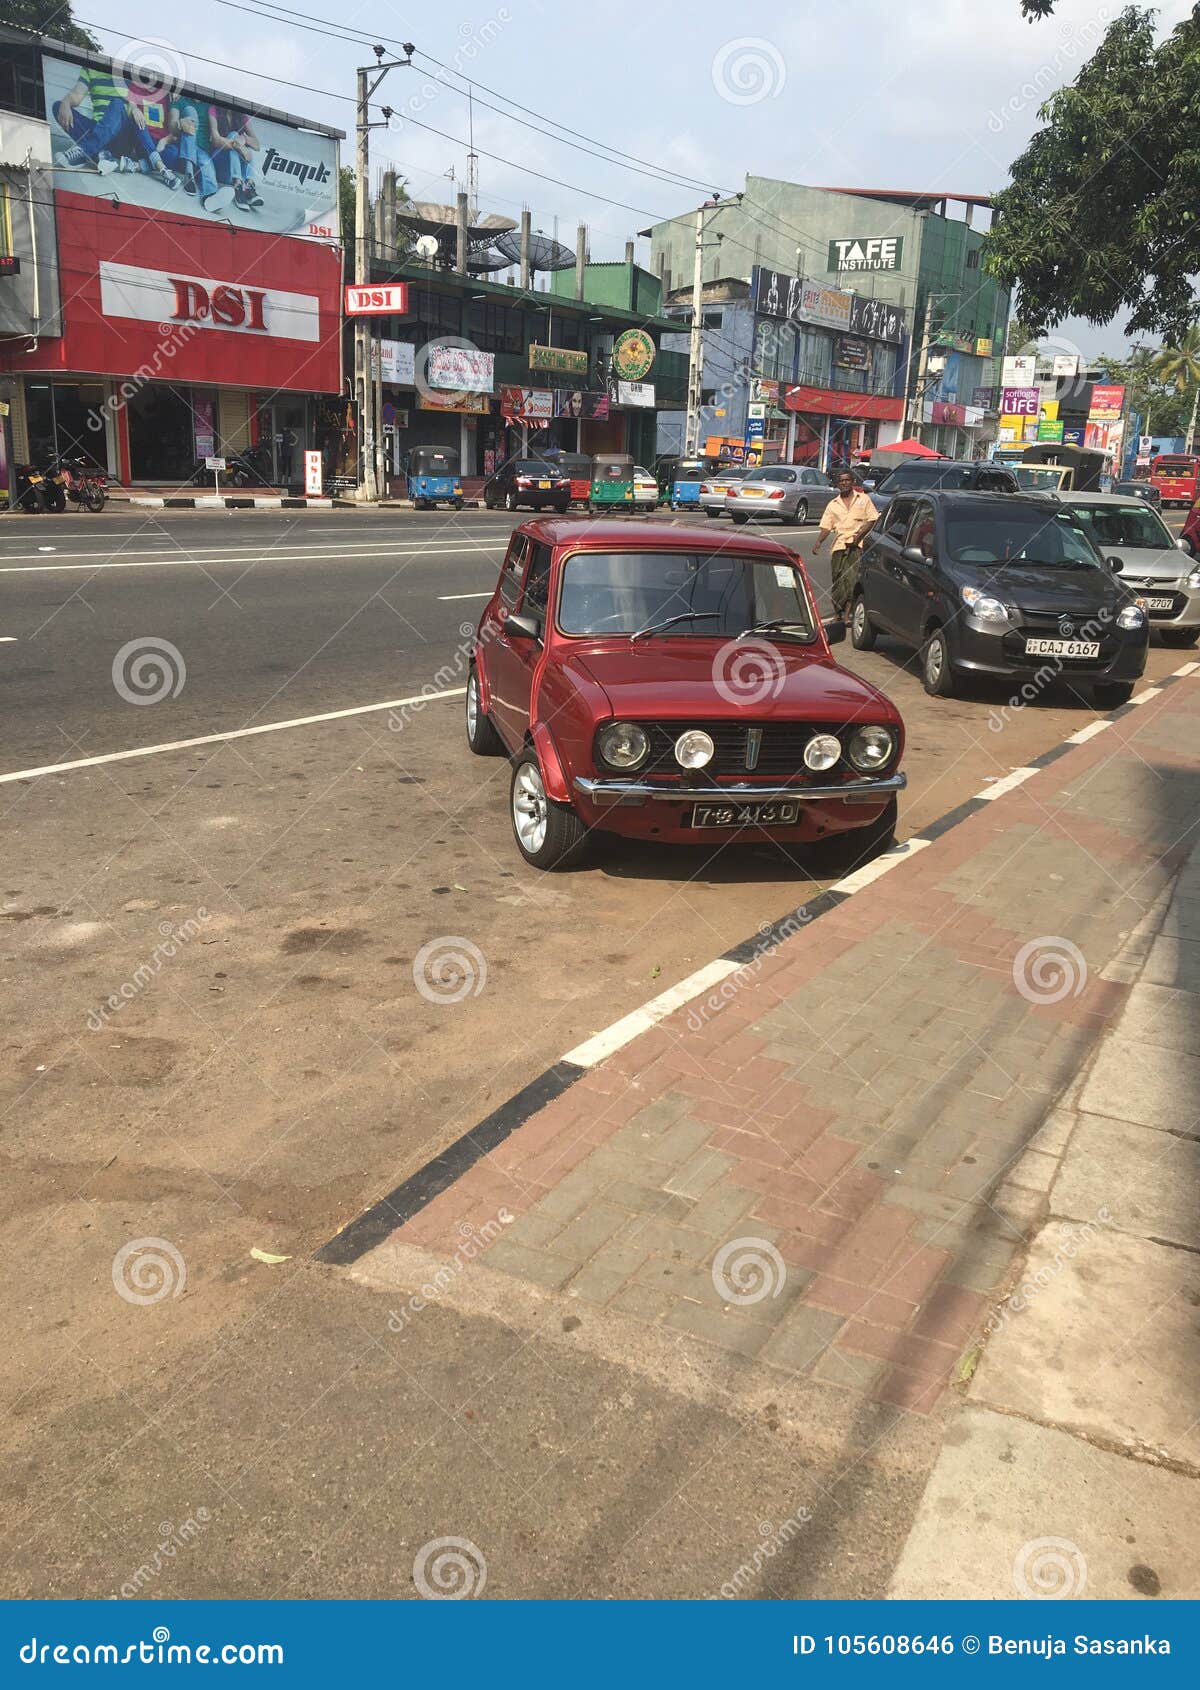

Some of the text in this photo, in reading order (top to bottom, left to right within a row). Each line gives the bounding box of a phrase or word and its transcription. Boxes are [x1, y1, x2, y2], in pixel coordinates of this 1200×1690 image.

[835, 239, 897, 260] TAFE
[838, 258, 895, 270] INSTITUTE
[168, 279, 268, 331] DSI
[357, 291, 392, 307] DSI
[1006, 390, 1037, 400] softlogic
[1039, 641, 1064, 653] CAJ
[1067, 643, 1098, 655] 6167
